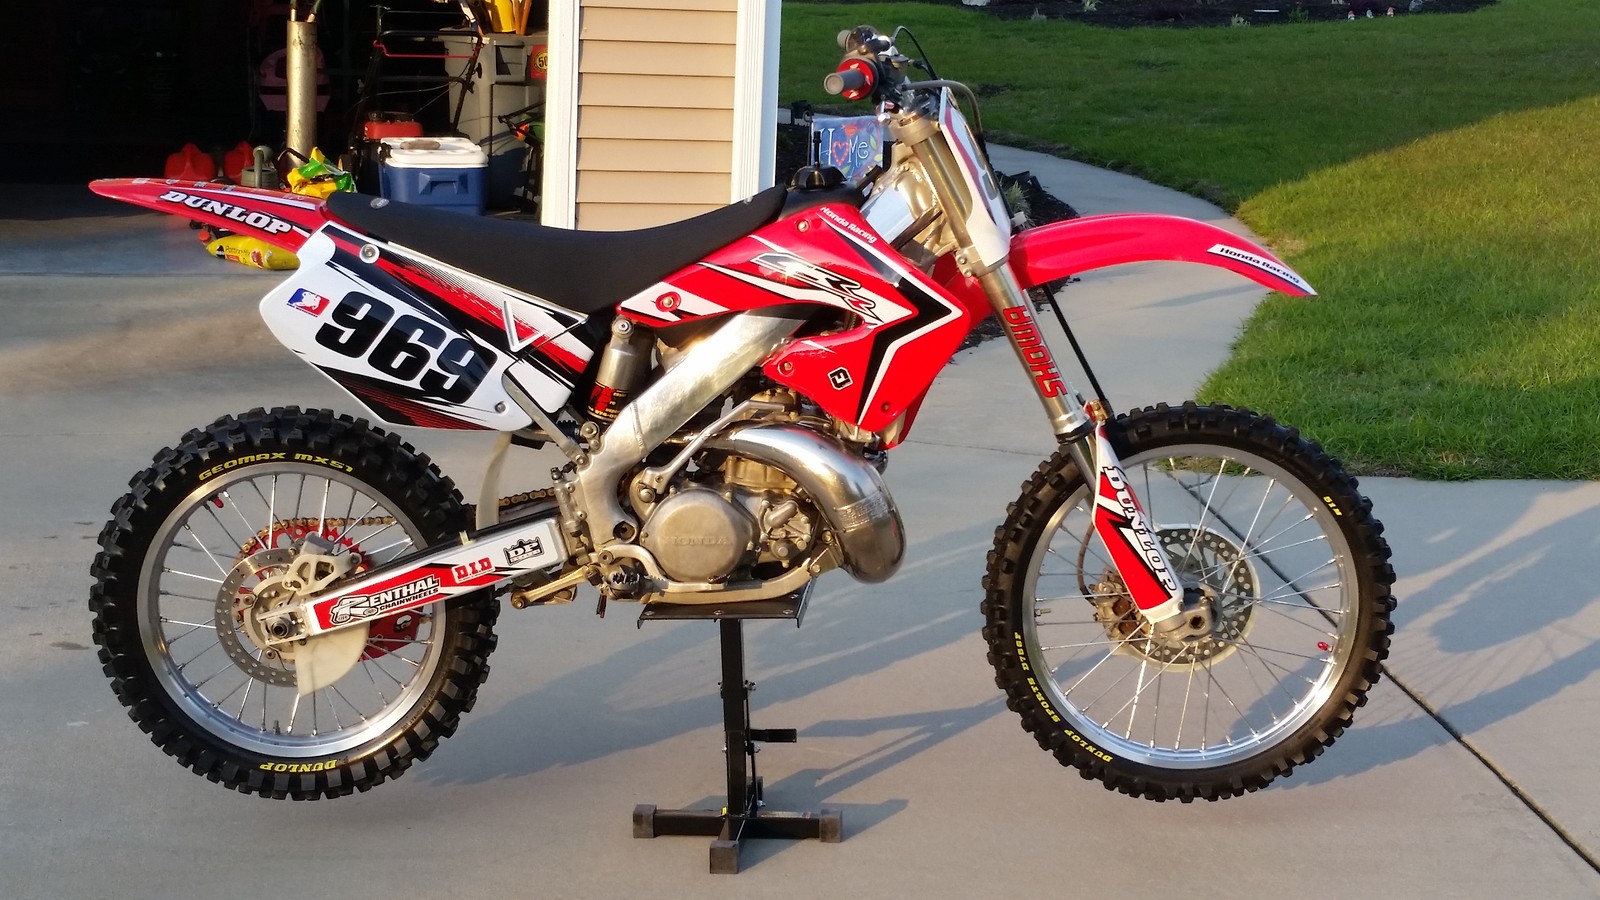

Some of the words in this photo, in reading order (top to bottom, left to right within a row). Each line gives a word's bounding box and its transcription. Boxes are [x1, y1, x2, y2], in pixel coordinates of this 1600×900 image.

[160, 190, 292, 234] DUNLOP
[820, 206, 849, 227] Honda
[847, 223, 878, 244] Racing
[1220, 247, 1260, 264] Honda
[1262, 261, 1300, 284] Racing
[315, 290, 499, 404] 969
[1003, 305, 1068, 398] SHOWA
[199, 452, 286, 481] GEOMAX
[294, 453, 353, 473] MX51
[663, 535, 729, 547] HONDA
[1102, 465, 1177, 591] DUNLOP
[331, 576, 440, 623] RENTHAL
[379, 587, 439, 611] CHAINWHEELS
[1027, 677, 1060, 722] SPORTS
[1064, 729, 1114, 762] DUNLOP
[260, 759, 338, 773] DUNLOP
